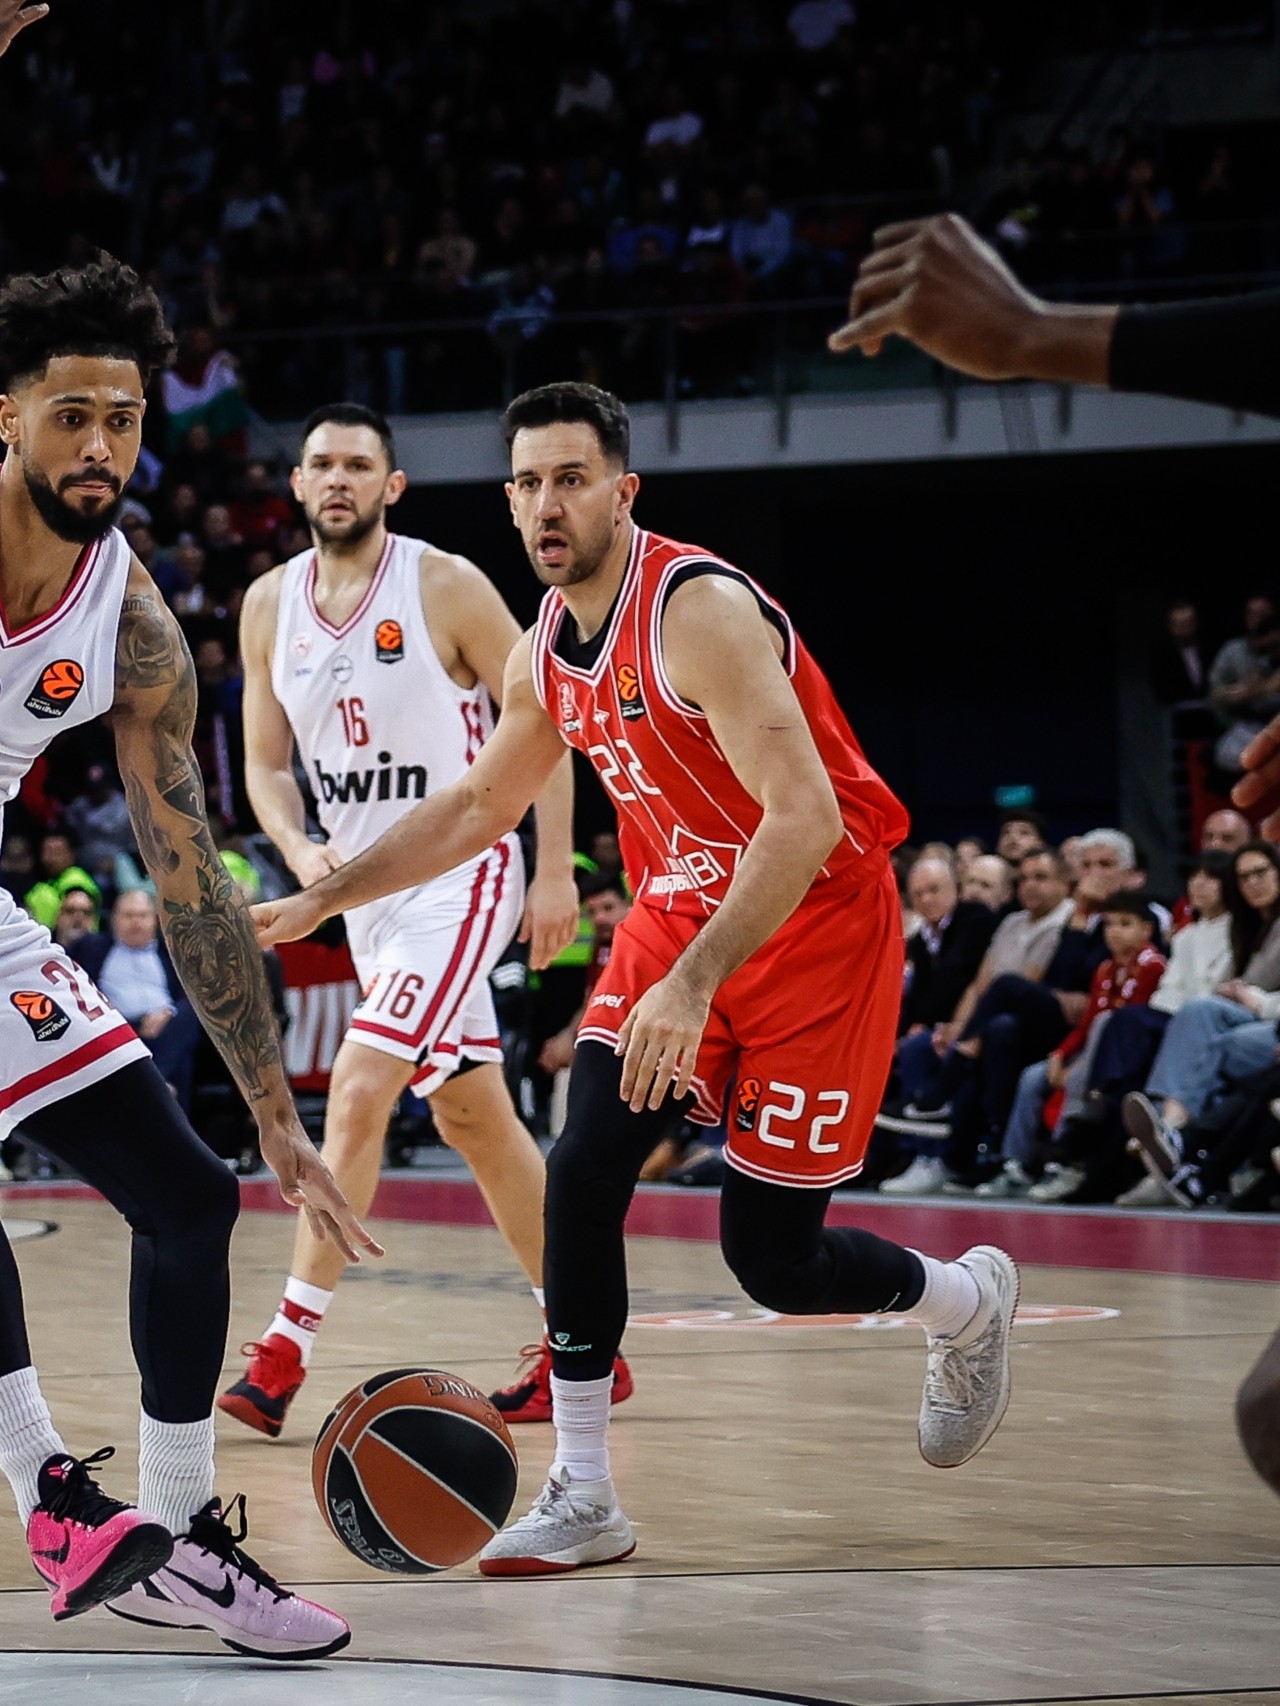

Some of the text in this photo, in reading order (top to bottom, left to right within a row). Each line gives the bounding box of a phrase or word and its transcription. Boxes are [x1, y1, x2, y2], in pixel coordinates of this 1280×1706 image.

[336, 697, 370, 748] 16
[314, 751, 427, 804] bwin
[587, 738, 662, 801] 22
[375, 969, 425, 1020] 16
[757, 1081, 850, 1154] 22
